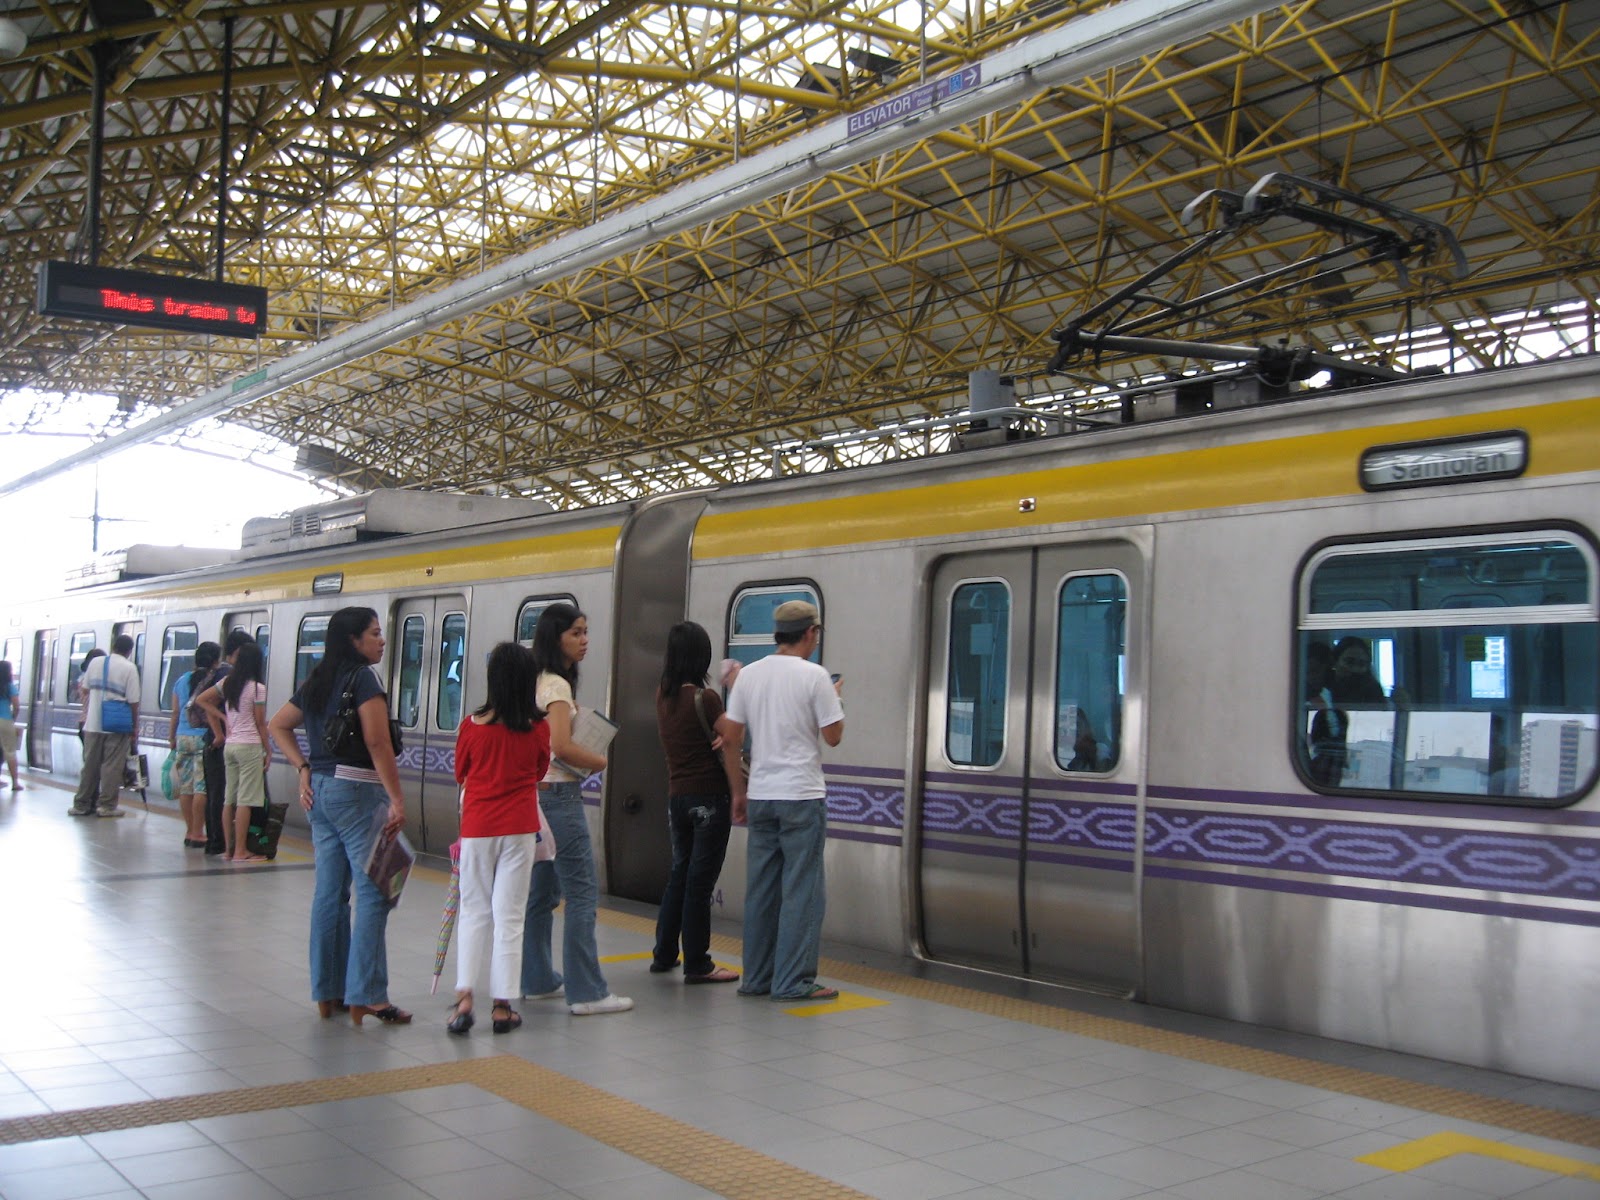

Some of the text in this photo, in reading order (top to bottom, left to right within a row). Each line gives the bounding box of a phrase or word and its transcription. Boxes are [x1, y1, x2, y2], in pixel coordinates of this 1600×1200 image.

[850, 96, 911, 132] ELEVATOR
[101, 289, 155, 312] This
[164, 298, 229, 321] train
